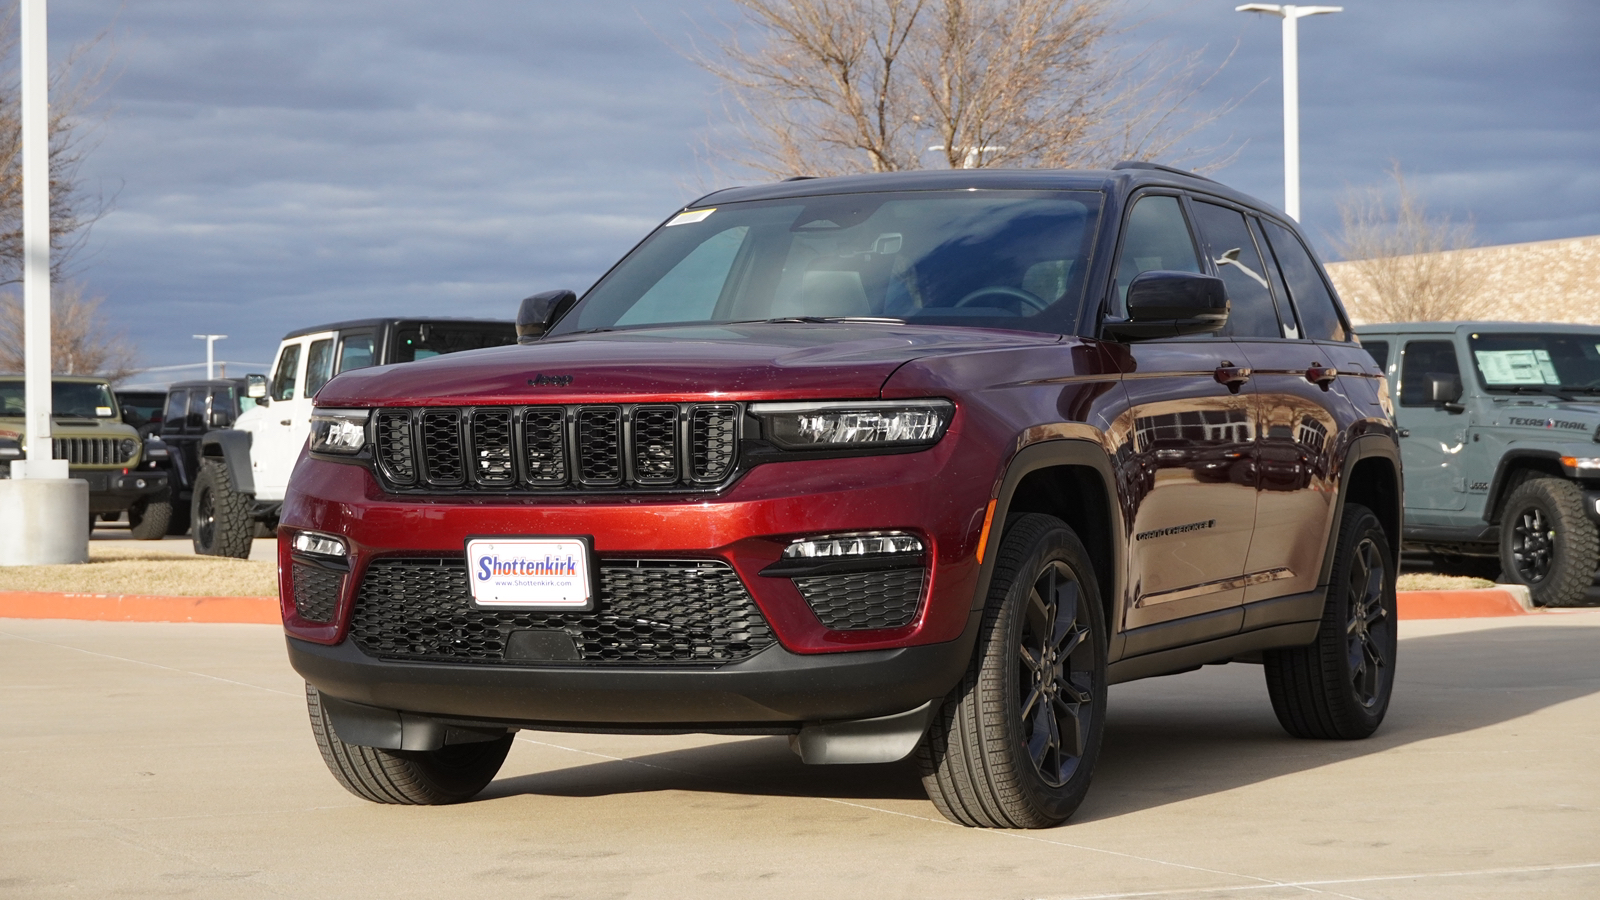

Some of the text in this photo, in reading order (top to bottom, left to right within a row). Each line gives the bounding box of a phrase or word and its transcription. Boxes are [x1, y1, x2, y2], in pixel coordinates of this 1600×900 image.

[527, 373, 574, 387] Jeep
[1508, 416, 1588, 431] TEXAS TRAIL
[477, 556, 576, 581] Shottenkirk
